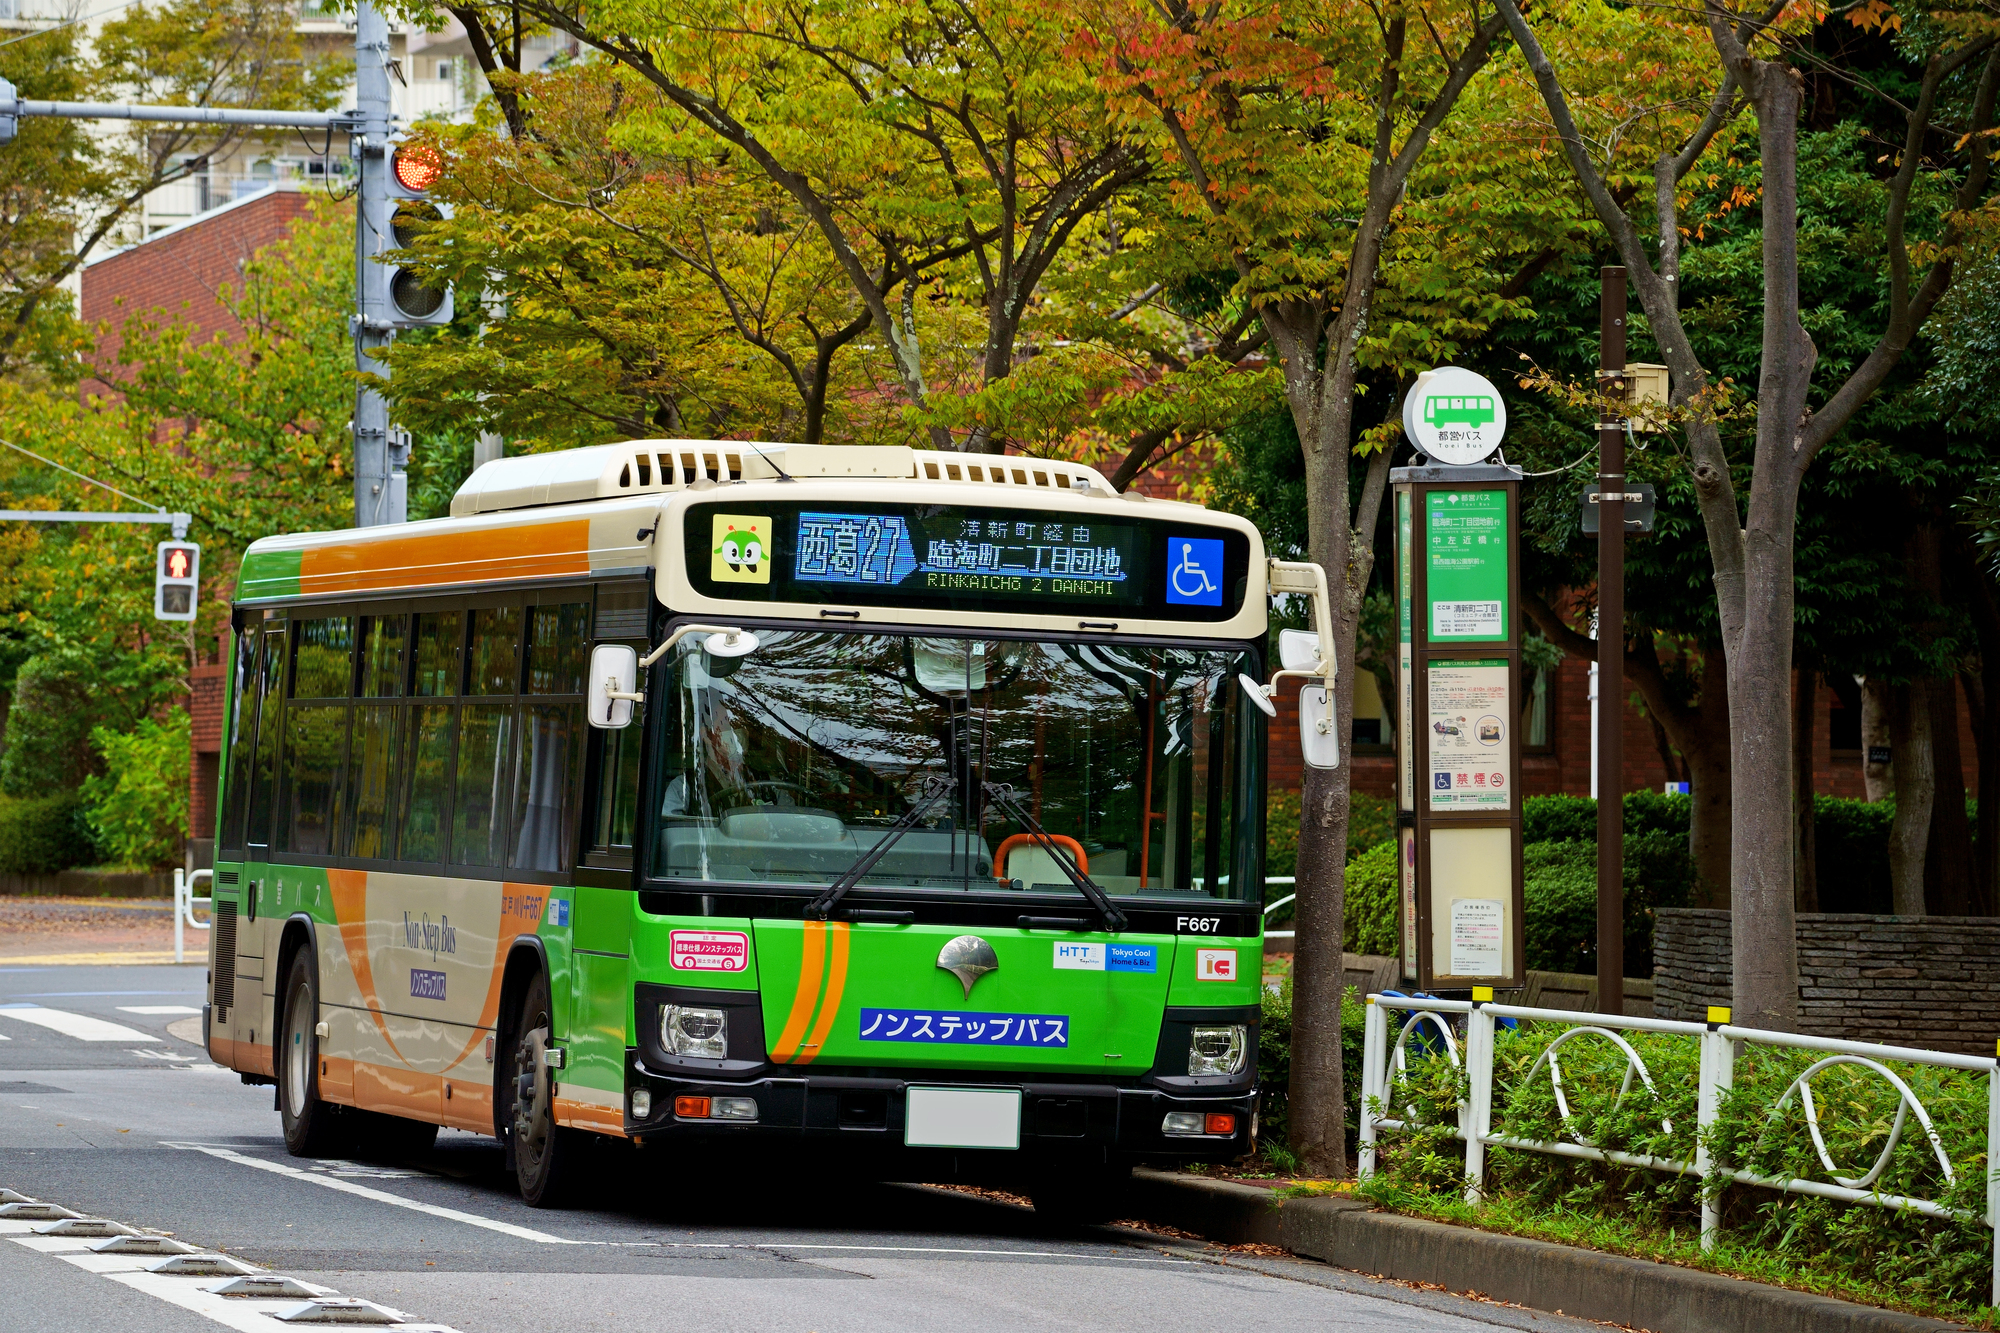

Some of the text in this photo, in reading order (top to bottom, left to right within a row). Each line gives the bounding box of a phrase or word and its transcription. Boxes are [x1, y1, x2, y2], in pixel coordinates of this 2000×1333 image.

[1438, 431, 1482, 441] 都営バス
[1461, 494, 1490, 502] 都営バス
[960, 520, 1090, 543] 清新町経由
[927, 539, 1121, 576] 臨海町二丁目団地
[1032, 577, 1042, 593] 2
[1052, 579, 1113, 595] DANCHI
[1454, 604, 1498, 613] 清新町二丁目
[1163, 649, 1208, 665] F667
[1456, 773, 1486, 785] 禁煙
[1177, 916, 1220, 933] F667
[441, 914, 456, 954] Bus
[676, 943, 742, 954] 標準仕様ノンステップバス
[1060, 946, 1090, 957] HTT
[1111, 948, 1151, 957] Tokyo Cool
[1111, 958, 1132, 966] Home
[1133, 958, 1138, 966] &
[411, 972, 446, 998] ノンステップバス
[861, 1013, 1066, 1043] ノンステップバス
